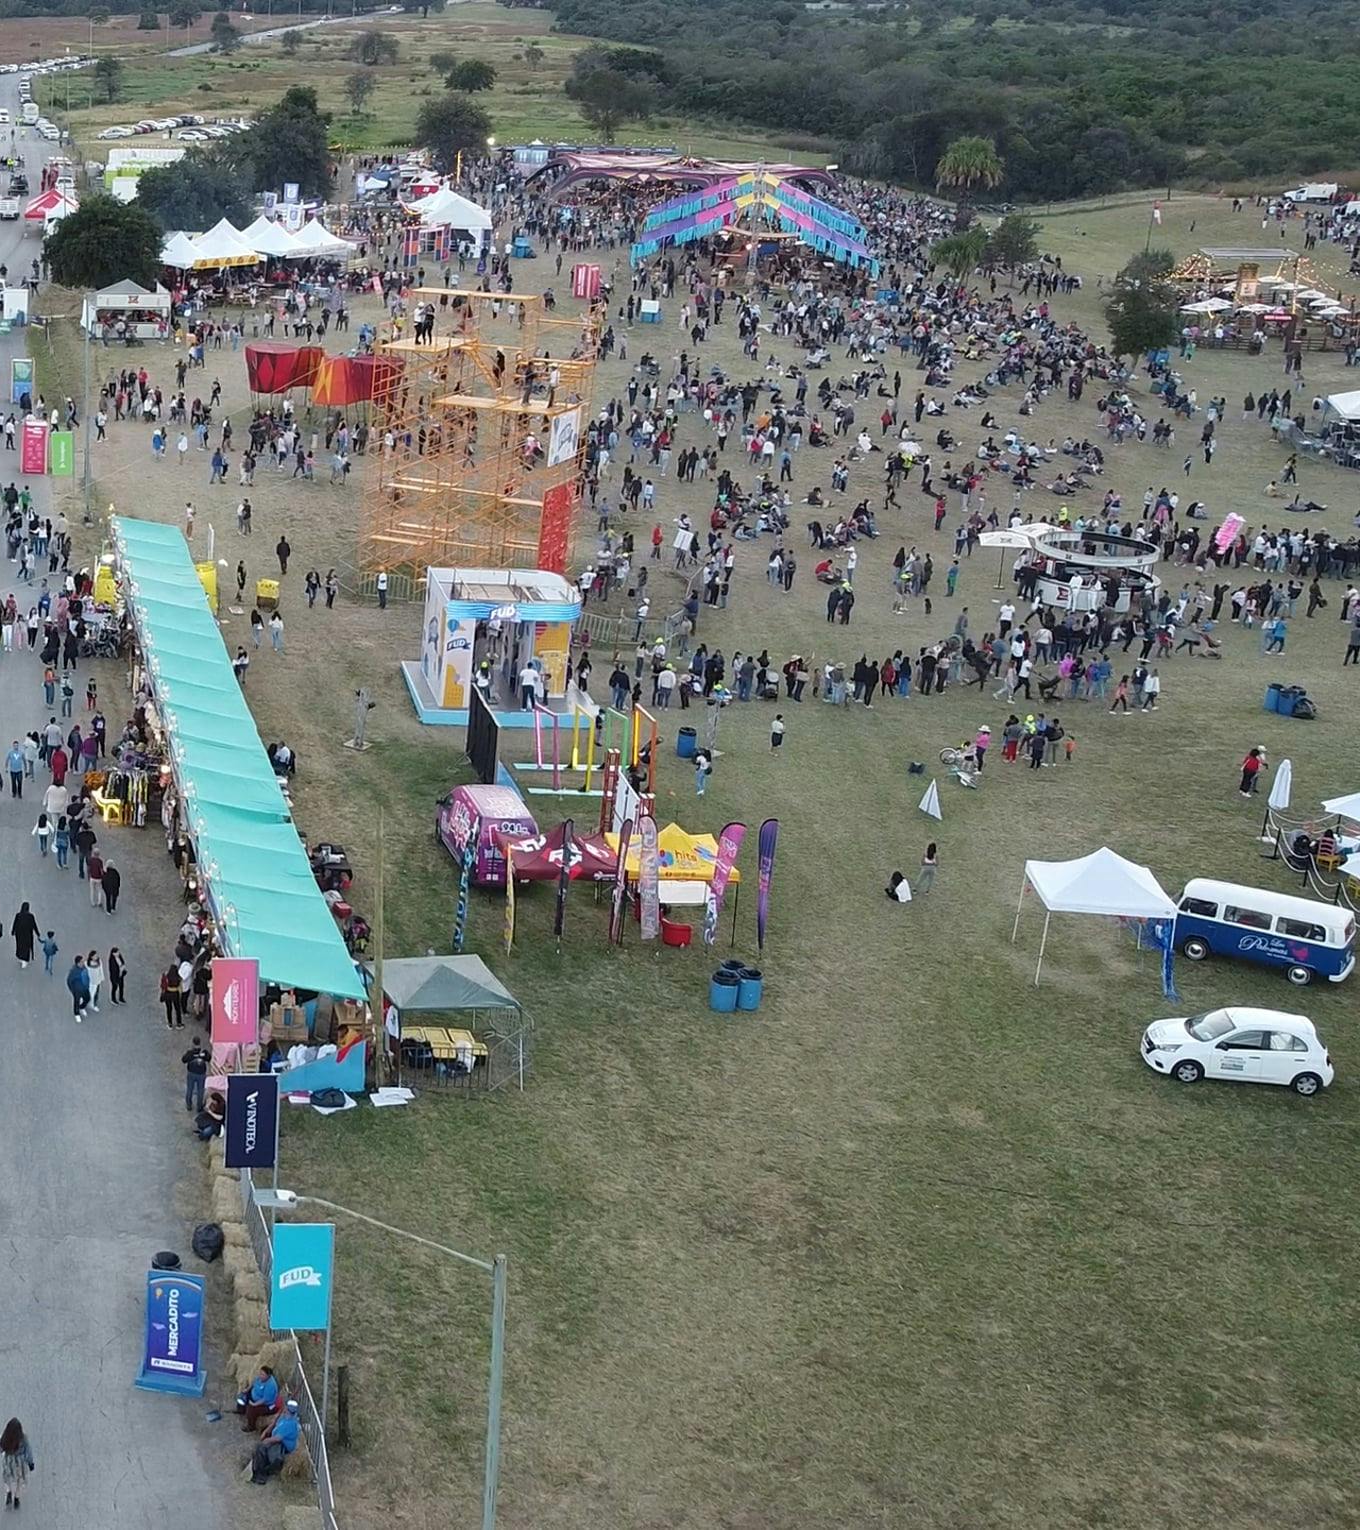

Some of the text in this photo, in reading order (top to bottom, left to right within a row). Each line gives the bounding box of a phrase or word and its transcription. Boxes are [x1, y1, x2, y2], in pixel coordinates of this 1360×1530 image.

[490, 604, 516, 620] FUD
[447, 638, 466, 650] FUD
[246, 1103, 258, 1154] VINOTECA
[282, 1268, 311, 1285] FUD
[168, 1288, 180, 1357] MERCADITO
